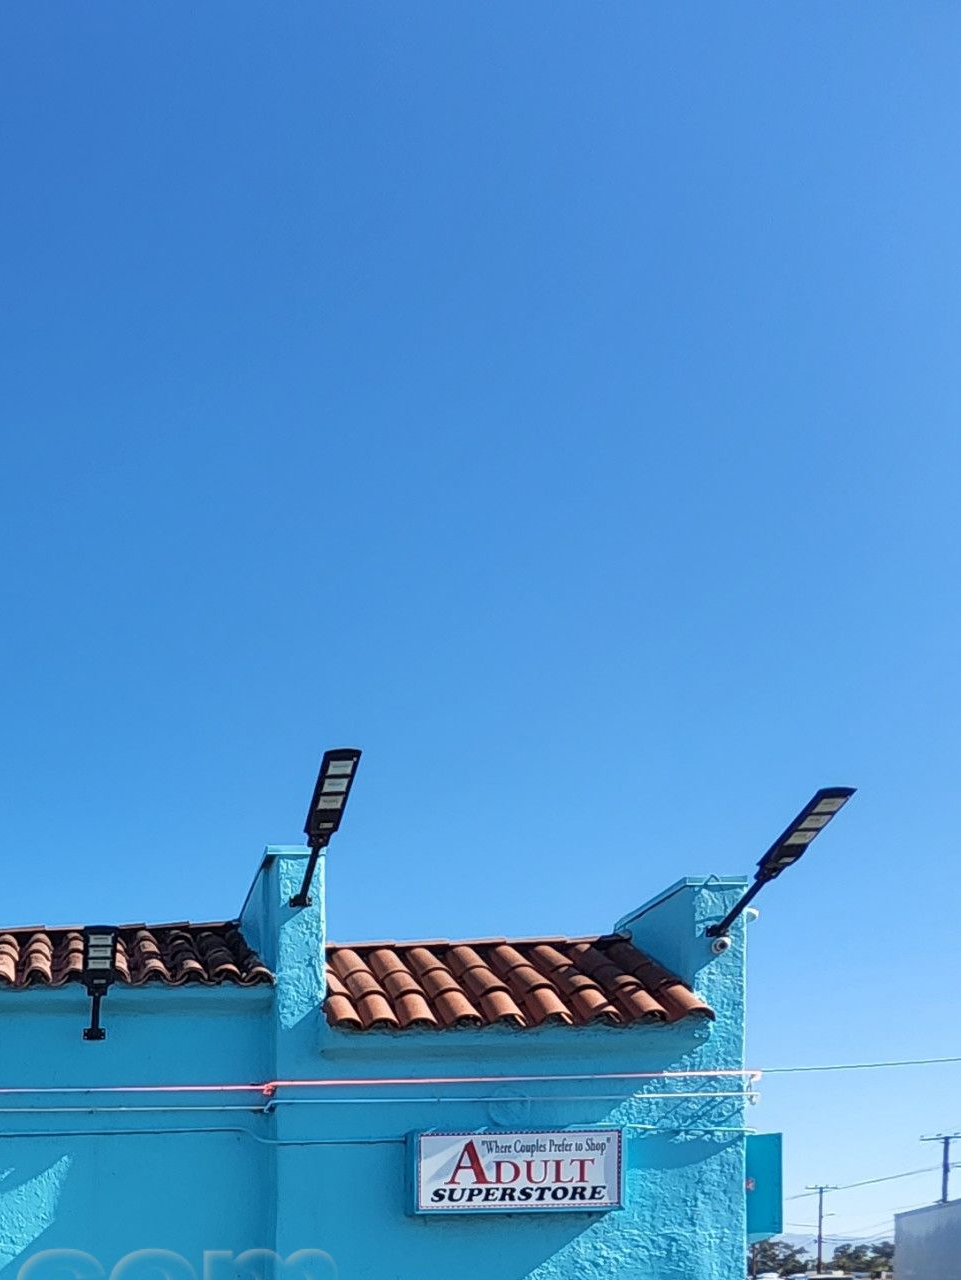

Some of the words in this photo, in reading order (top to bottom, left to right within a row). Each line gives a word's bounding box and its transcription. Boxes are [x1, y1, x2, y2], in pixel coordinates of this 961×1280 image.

[513, 1138, 547, 1157] Couples
[548, 1138, 573, 1153] Prefer
[575, 1139, 583, 1152] to
[444, 1139, 595, 1186] ADULT
[431, 1184, 607, 1203] SUPERSTORE
